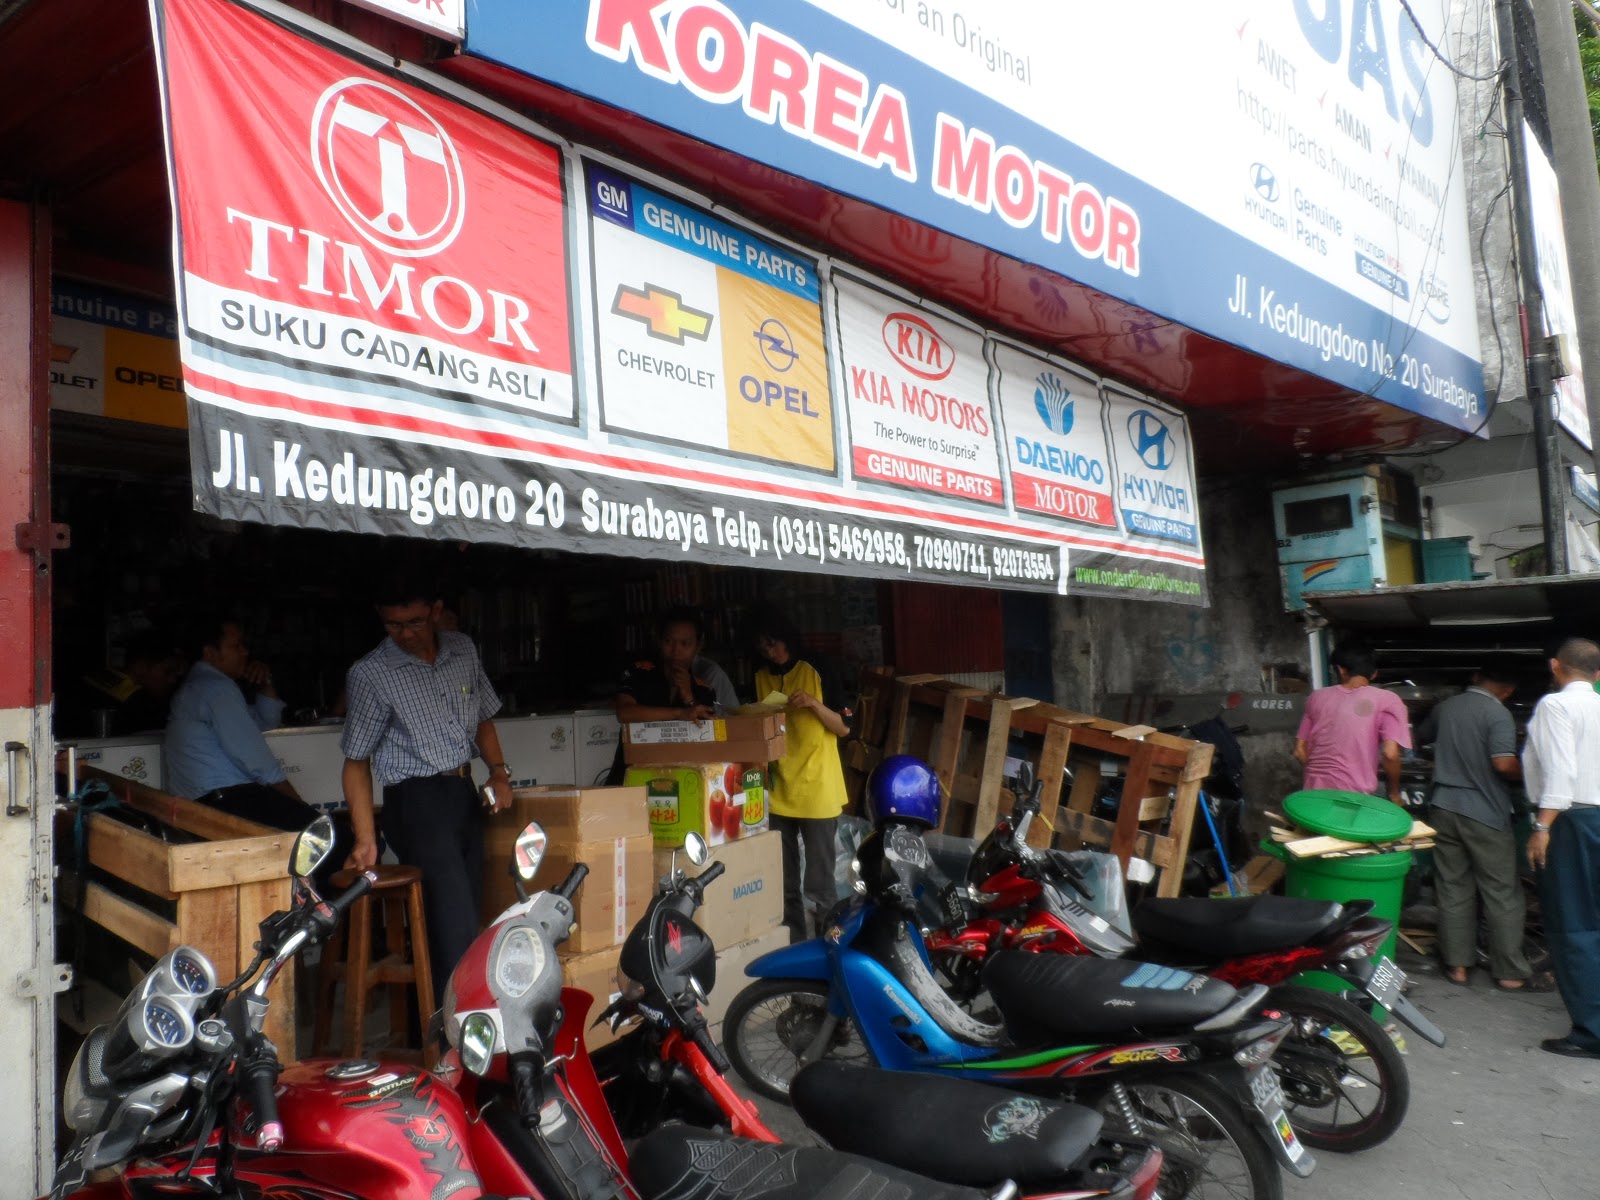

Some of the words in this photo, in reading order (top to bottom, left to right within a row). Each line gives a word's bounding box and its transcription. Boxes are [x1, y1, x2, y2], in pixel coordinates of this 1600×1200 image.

[918, 1, 944, 36] an
[953, 13, 1031, 86] Original
[1257, 38, 1298, 94] AWET
[590, 0, 915, 178] KOREA
[935, 117, 1139, 273] MOTOR
[1335, 102, 1372, 153] AMAN
[596, 180, 628, 212] GM
[1244, 192, 1288, 234] HYUNDAI
[1294, 187, 1343, 238] Genuine
[642, 202, 741, 261] GENUINE
[745, 245, 807, 287] PARTS
[1296, 219, 1328, 257] Parts
[226, 206, 541, 353] TIMOR
[52, 294, 138, 326] nuine
[220, 299, 327, 351] SUKU
[341, 327, 480, 385] CADANG
[487, 367, 548, 402] ASLI
[896, 321, 943, 369] KIA
[1228, 274, 1252, 319] Jl.
[1259, 286, 1368, 369] Kedungdoro
[1372, 339, 1396, 381] No.
[1401, 353, 1419, 390] 20
[1422, 363, 1478, 419] Surabaya
[617, 349, 715, 389] CHEVROLET
[739, 375, 819, 418] OPEL
[851, 365, 895, 409] KIA
[901, 381, 989, 437] MOTORS
[873, 421, 894, 440] The
[896, 427, 927, 449] Power
[928, 437, 938, 451] to
[867, 453, 943, 487] GENUINE
[946, 471, 993, 497] PARTS
[1015, 435, 1104, 485] DAEWOO
[213, 429, 260, 493] Jl.
[273, 440, 516, 525] Kedungdoro
[525, 479, 565, 528] 20
[581, 487, 708, 552] Surabaya
[712, 506, 768, 558] Telp.
[773, 516, 824, 564] (031)
[828, 523, 911, 573] 5462958,
[914, 535, 992, 581] 70990711,
[993, 547, 1053, 580] 92073554
[1032, 482, 1099, 520] MOTOR
[1124, 472, 1190, 514] HYUNDAI
[1167, 522, 1192, 539] PARTS
[1252, 699, 1293, 710] KOREA
[946, 891, 963, 920] 5660
[1371, 965, 1393, 991] 5660
[1382, 955, 1397, 970] Z
